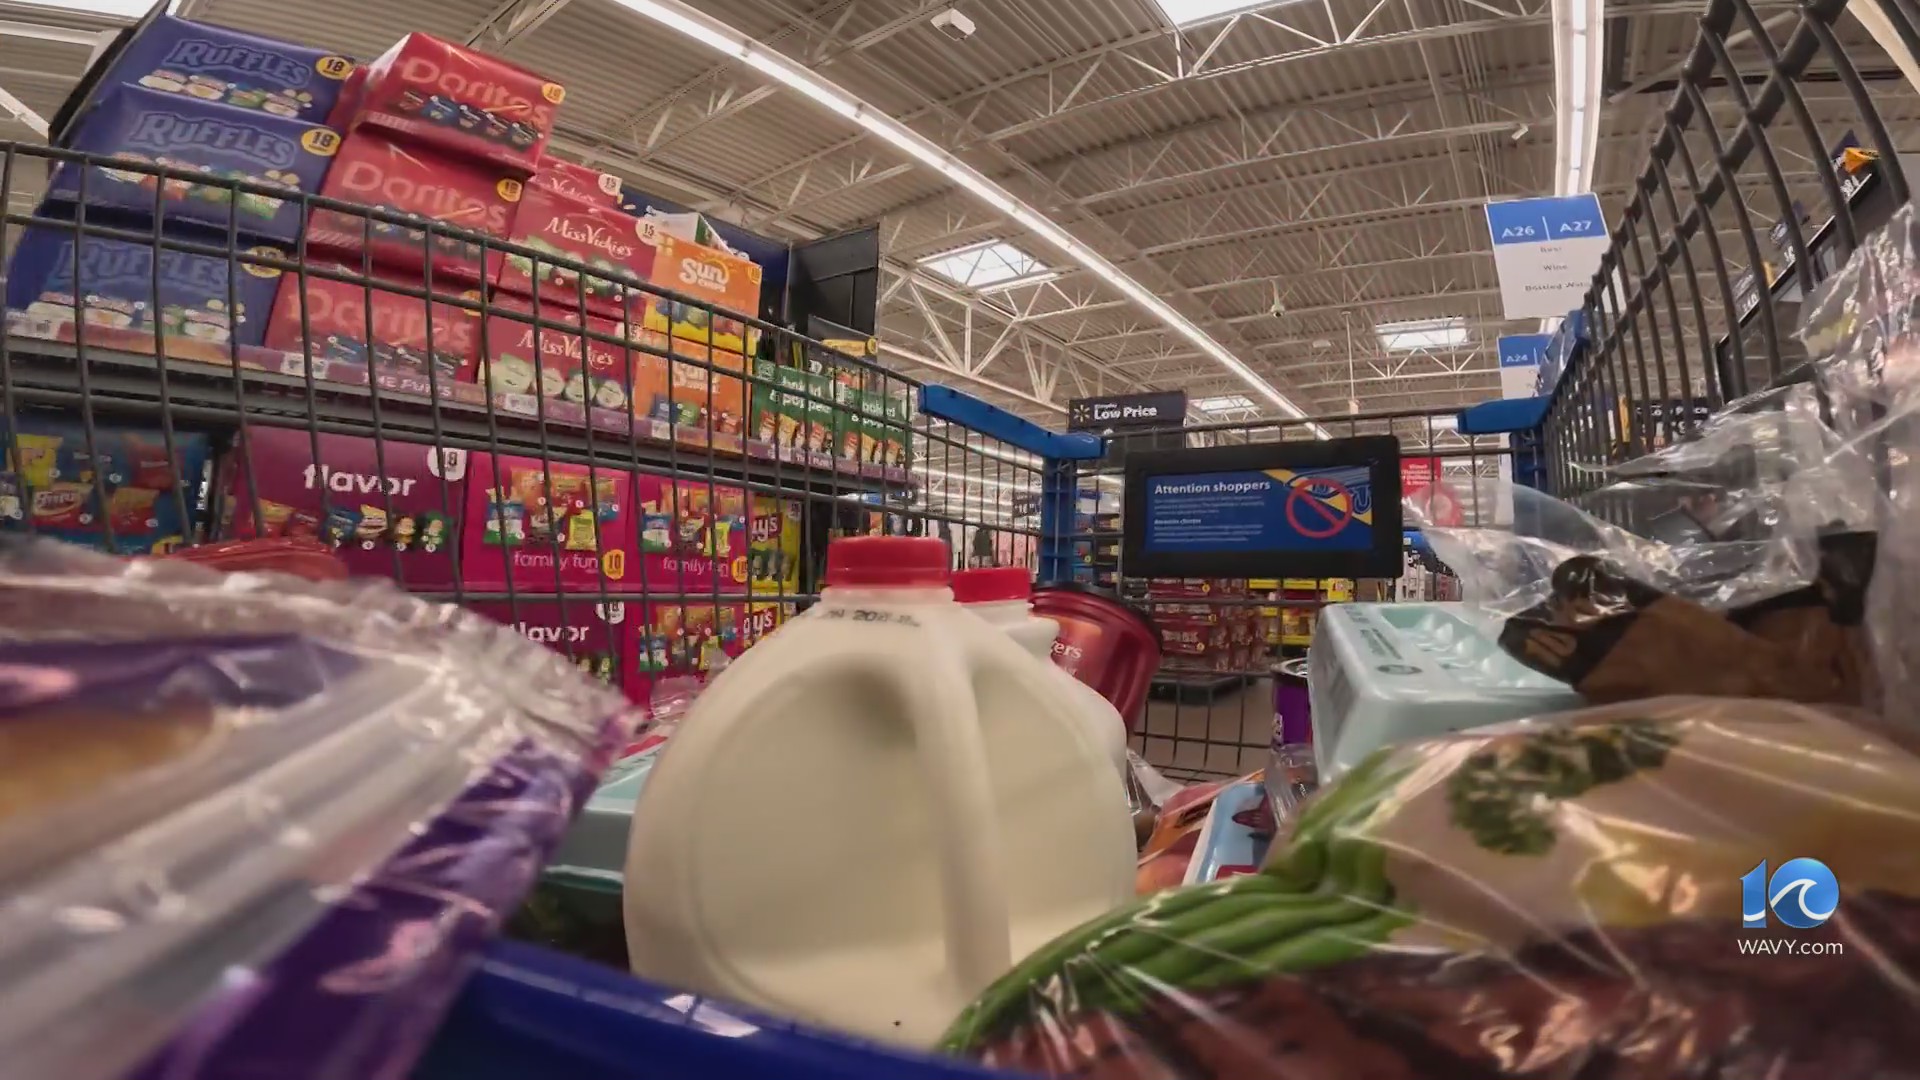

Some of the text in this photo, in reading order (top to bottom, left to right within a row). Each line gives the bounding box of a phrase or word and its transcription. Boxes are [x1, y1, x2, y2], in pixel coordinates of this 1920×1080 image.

[170, 41, 310, 86] RUFFLES
[325, 58, 344, 73] 18
[402, 57, 549, 127] Doritos
[136, 113, 293, 165] RUFFLES
[312, 131, 335, 147] 18
[341, 161, 507, 232] Doritos
[643, 222, 655, 234] 15
[1502, 220, 1592, 239] A26 A27
[679, 257, 729, 285] Sun
[286, 287, 472, 349] Doritos
[1094, 408, 1121, 420] Low
[1123, 404, 1158, 418] Price
[302, 463, 417, 497] flavor
[1154, 481, 1271, 495] Attention shoppers
[514, 550, 599, 572] famiy fun
[608, 556, 622, 571] 10
[510, 621, 590, 642] lavor
